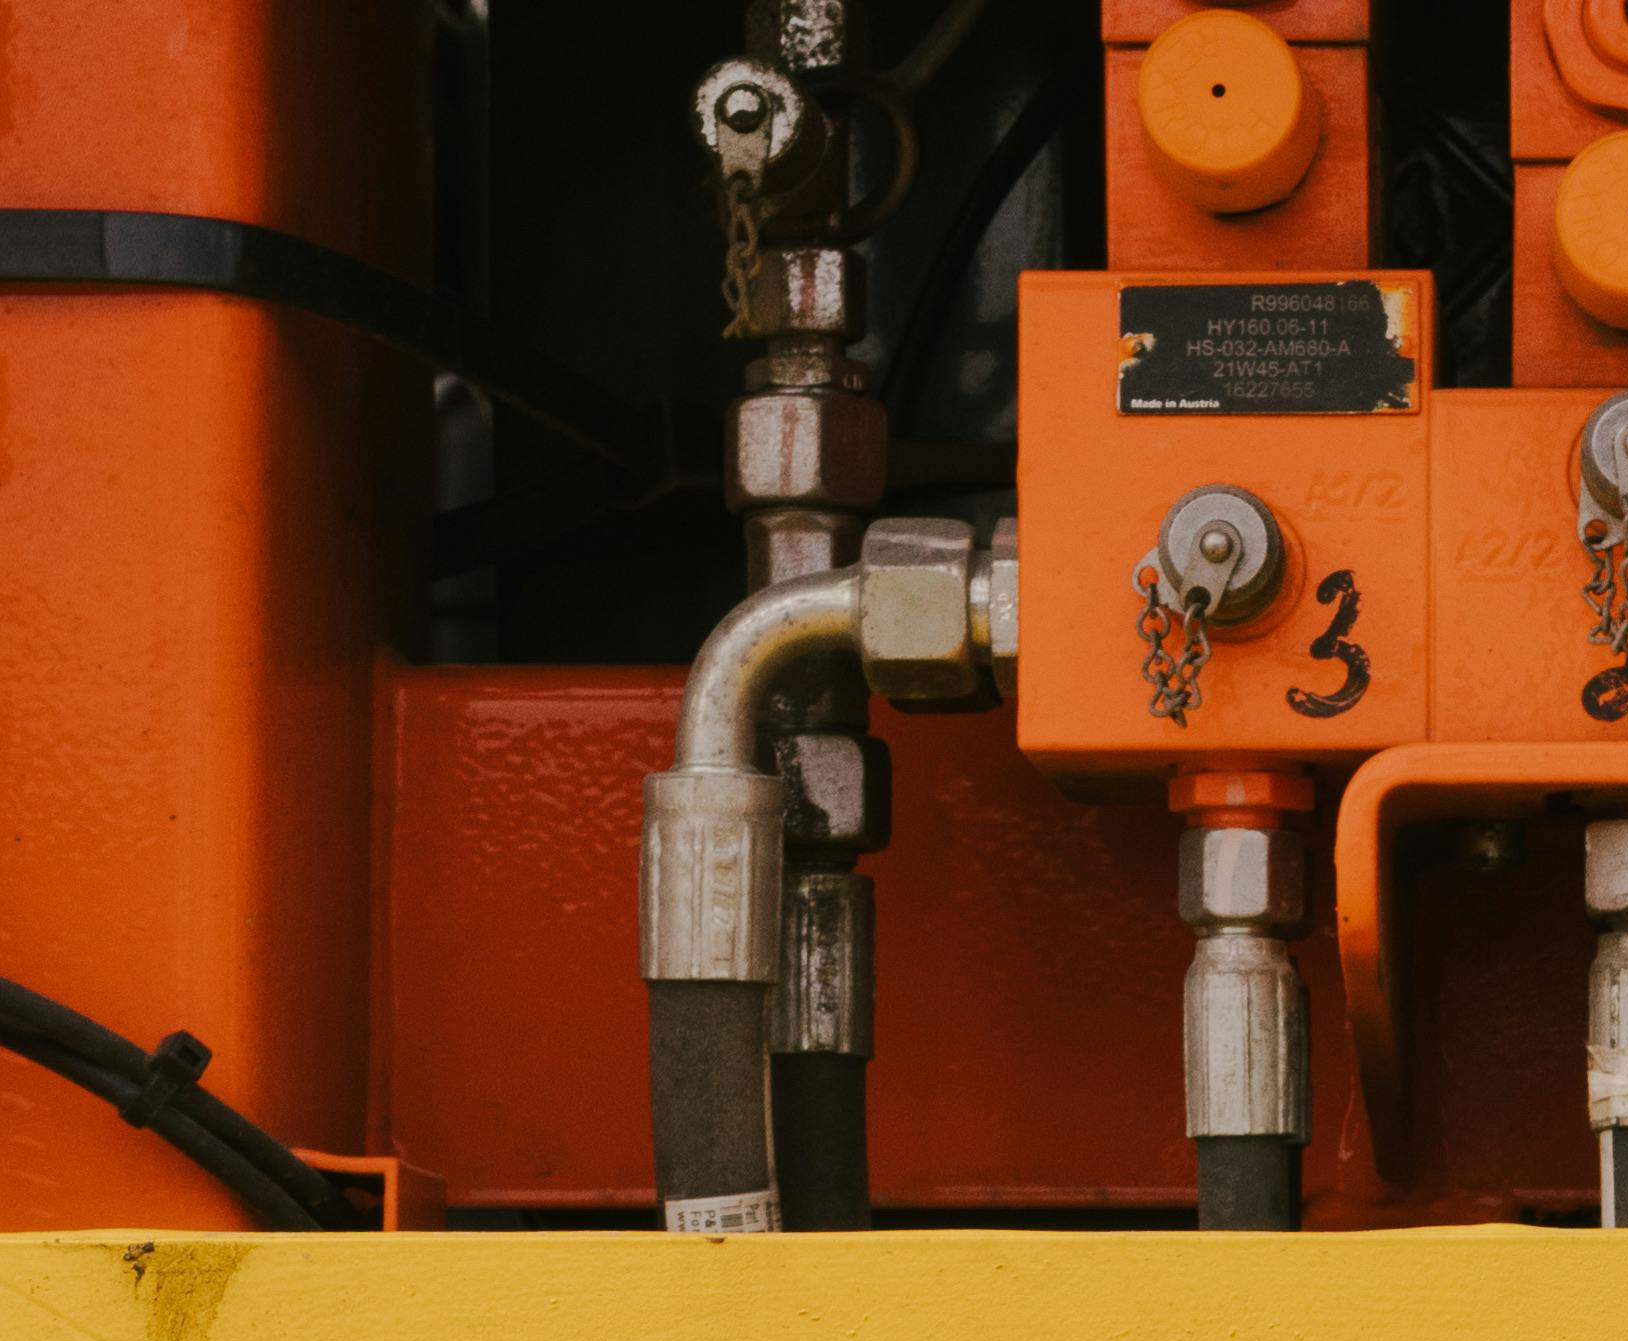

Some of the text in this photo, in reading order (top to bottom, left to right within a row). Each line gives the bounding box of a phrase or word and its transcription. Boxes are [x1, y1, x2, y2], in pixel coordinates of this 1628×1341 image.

[1207, 319, 1329, 335] HY160.06-11
[1187, 340, 1351, 356] HS-032-AM680-A
[1213, 361, 1323, 377] 21W45-AT1
[1131, 399, 1220, 409] Made in Austria
[1286, 569, 1371, 718] 3
